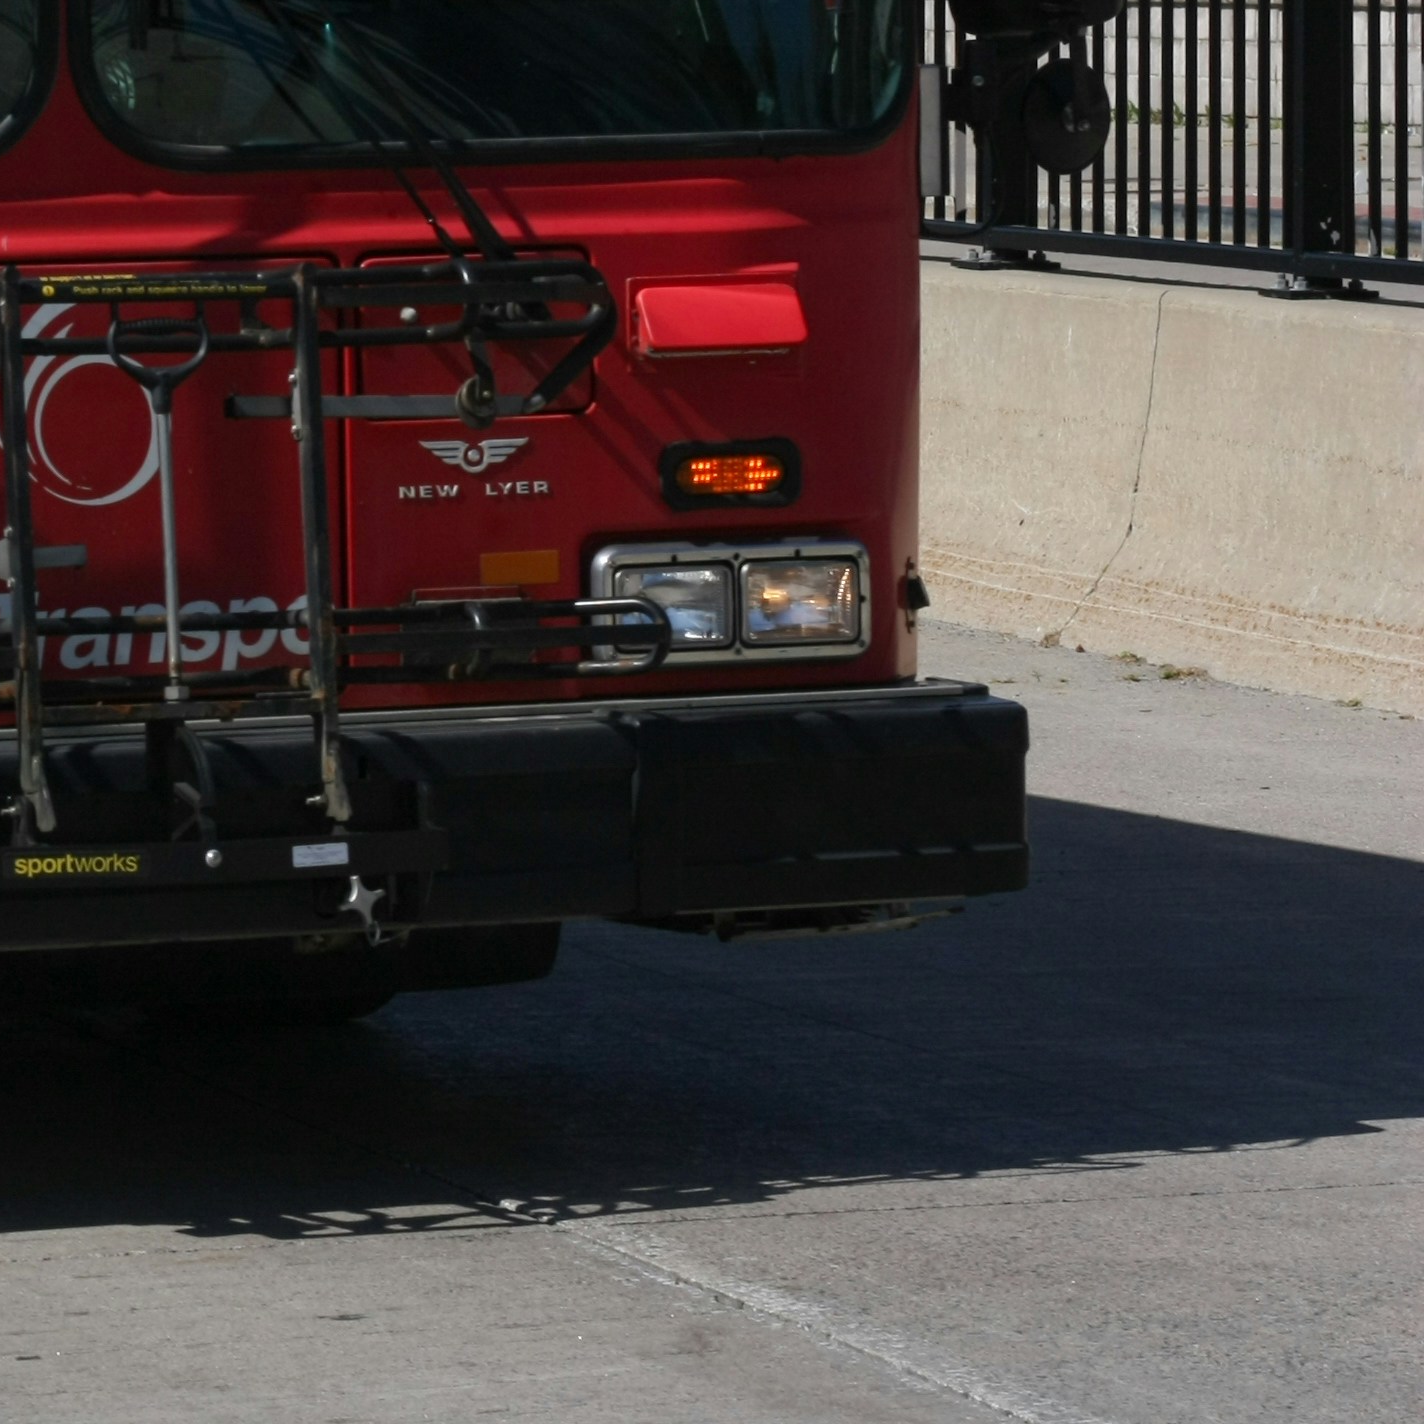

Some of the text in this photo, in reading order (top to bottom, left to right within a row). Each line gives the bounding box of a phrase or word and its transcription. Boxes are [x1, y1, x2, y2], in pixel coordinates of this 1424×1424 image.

[398, 481, 549, 499] NEW LYER
[14, 853, 139, 878] sportworks
